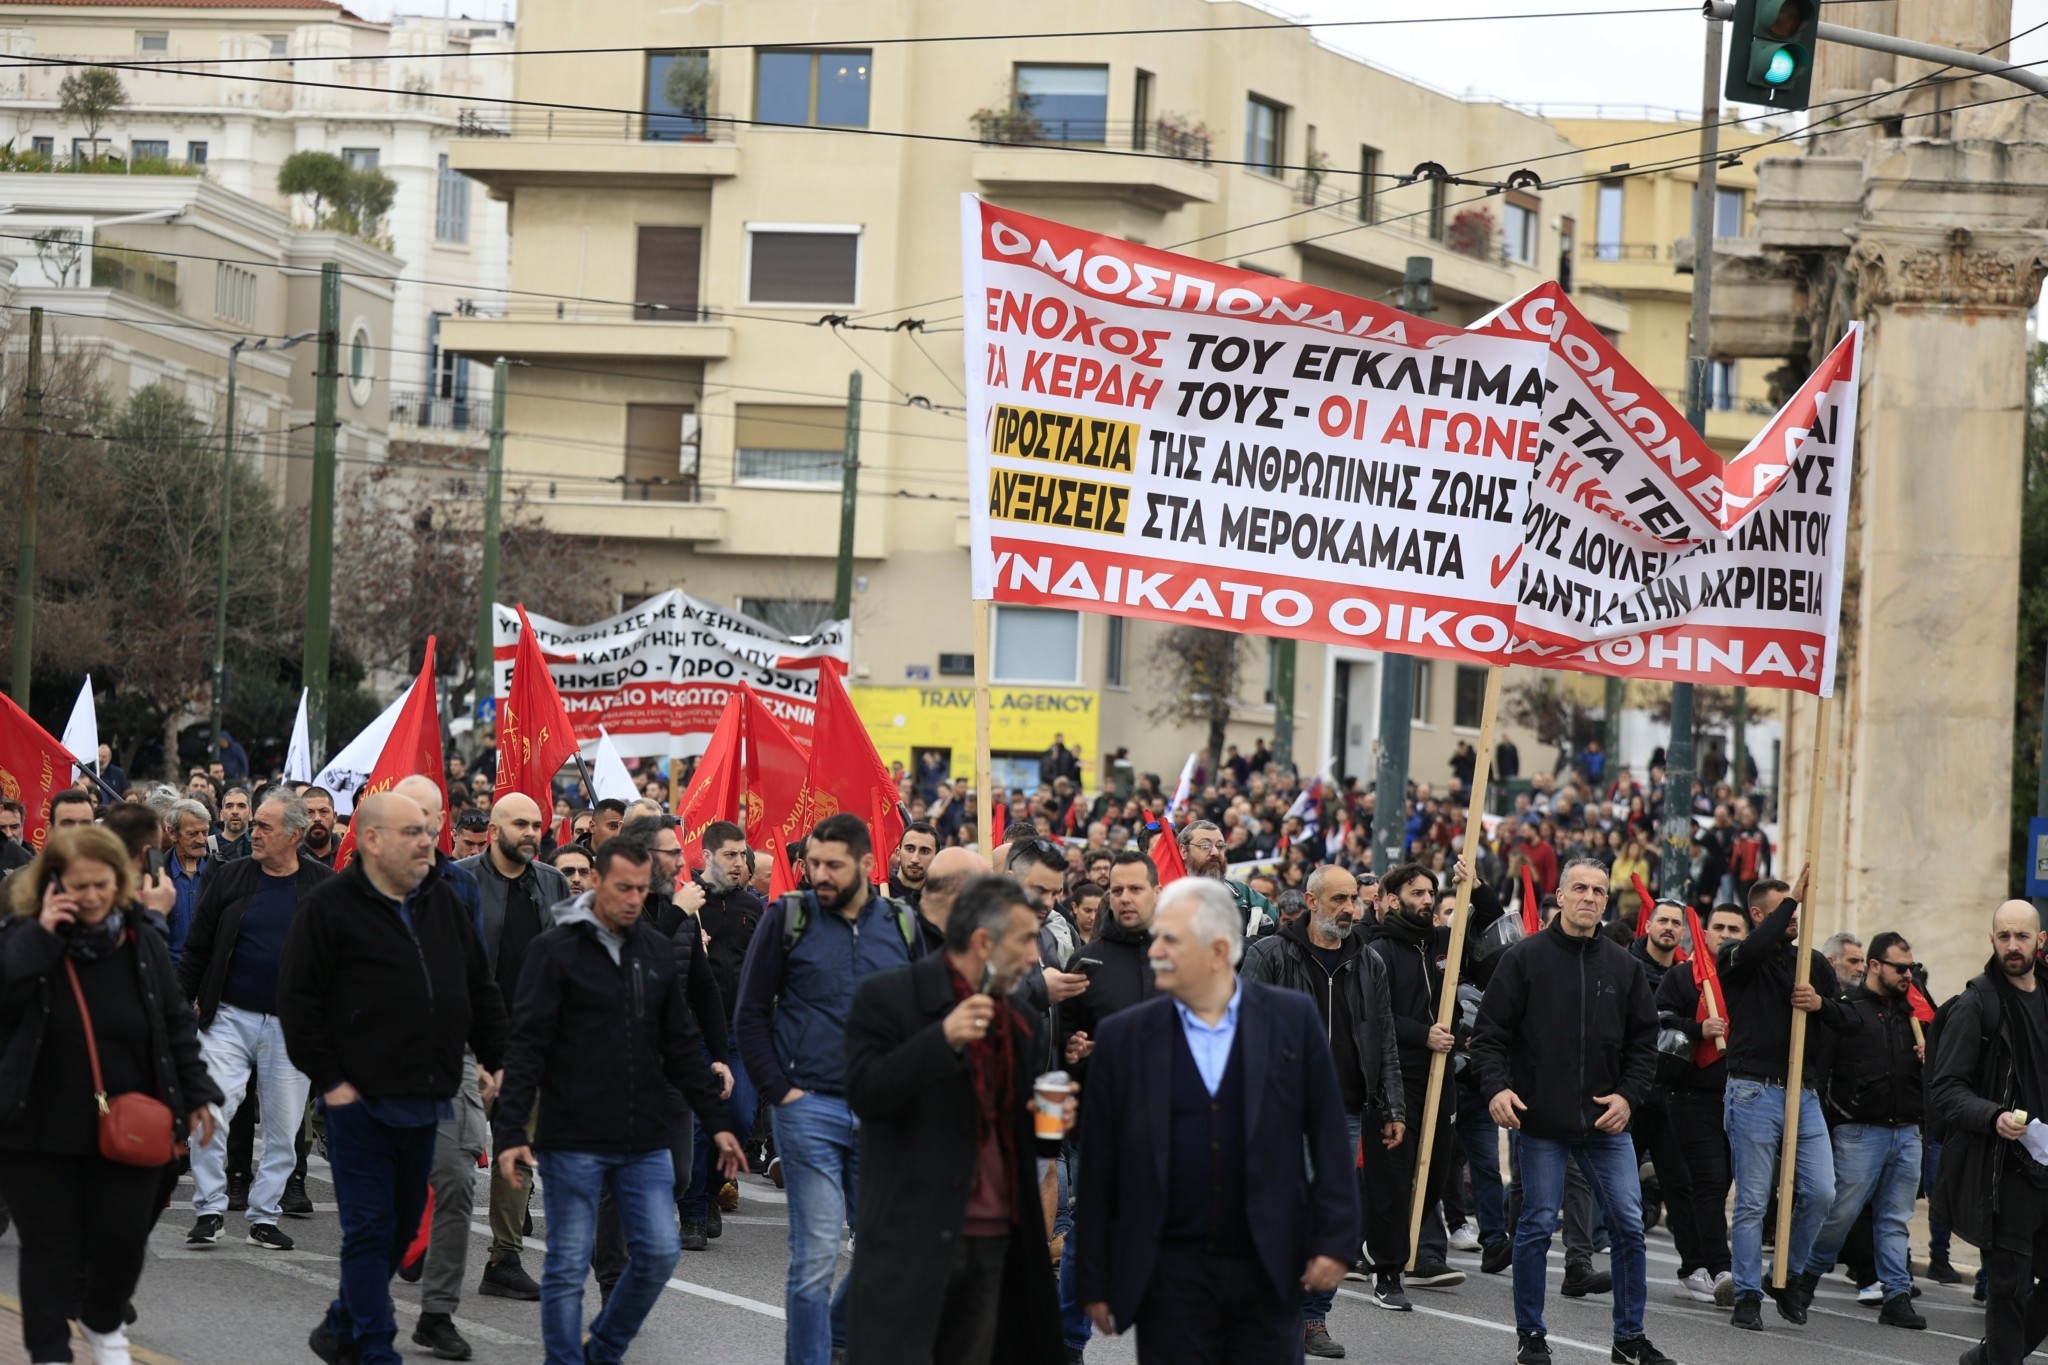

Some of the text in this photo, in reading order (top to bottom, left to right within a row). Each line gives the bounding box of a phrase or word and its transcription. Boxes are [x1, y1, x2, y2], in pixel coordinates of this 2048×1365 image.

[991, 221, 1408, 346] ΟΜΟΣΠΟΝΔΙΑ
[986, 288, 1171, 368] ΕΝΟΧΟΣ
[1186, 333, 1286, 375] ΤΟΥ
[1293, 343, 1547, 410] ΕΓΚΛΗΜΑ
[1548, 397, 1625, 474] ΣΤΑ
[986, 343, 1009, 388] ΤΑ
[1022, 350, 1164, 410] ΚΕΡΔΗ
[1177, 381, 1289, 429] ΤΟΥΣ
[1318, 395, 1367, 441] ΟΙ
[1381, 404, 1540, 463] ΑΓΩΝΕ
[990, 473, 1129, 534] ΑΥΞΗΣΕΙΣ
[1142, 492, 1206, 546] ΣΤΑ
[1220, 503, 1465, 580] ΜΕΡΟΚΑΜΑΤΑ
[1700, 567, 1823, 616] ΑΚΡΙΒΕΙΑ
[992, 406, 1132, 472] ΠΡΟΣΤΑΣΙΑ
[1149, 430, 1206, 481] ΤΗΣ
[1211, 441, 1421, 510] ΑΝΘΡΩΠΙΝΗΣ
[1427, 469, 1517, 524] ΖΩΗΣ
[1568, 527, 1670, 586] ΔΟΥΛΕΙ
[614, 613, 648, 636] ΣΣΕ
[692, 631, 726, 649] ΤΟ
[990, 551, 1314, 627] ΥΝΔΙΚΑΤΟ
[920, 690, 1094, 713] TRAV AGENCY
